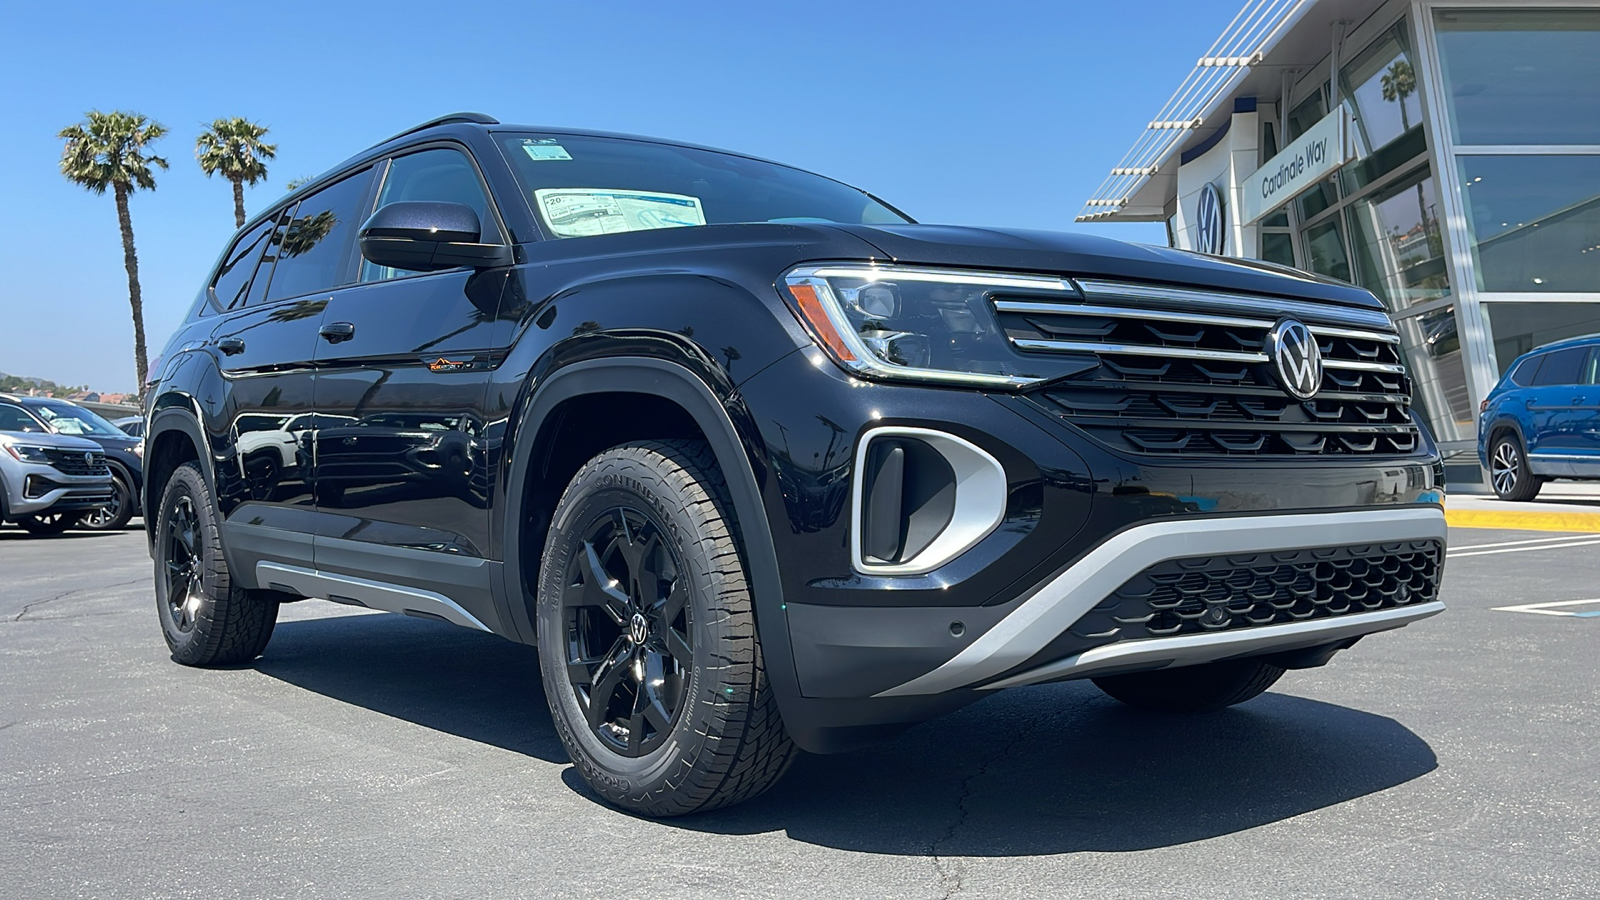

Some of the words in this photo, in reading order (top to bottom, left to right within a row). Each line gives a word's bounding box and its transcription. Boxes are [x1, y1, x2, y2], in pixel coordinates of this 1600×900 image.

[1262, 153, 1304, 199] Cardinale
[1306, 137, 1327, 168] Way
[594, 472, 685, 553] CONTINENTAL
[685, 665, 701, 727] Continental
